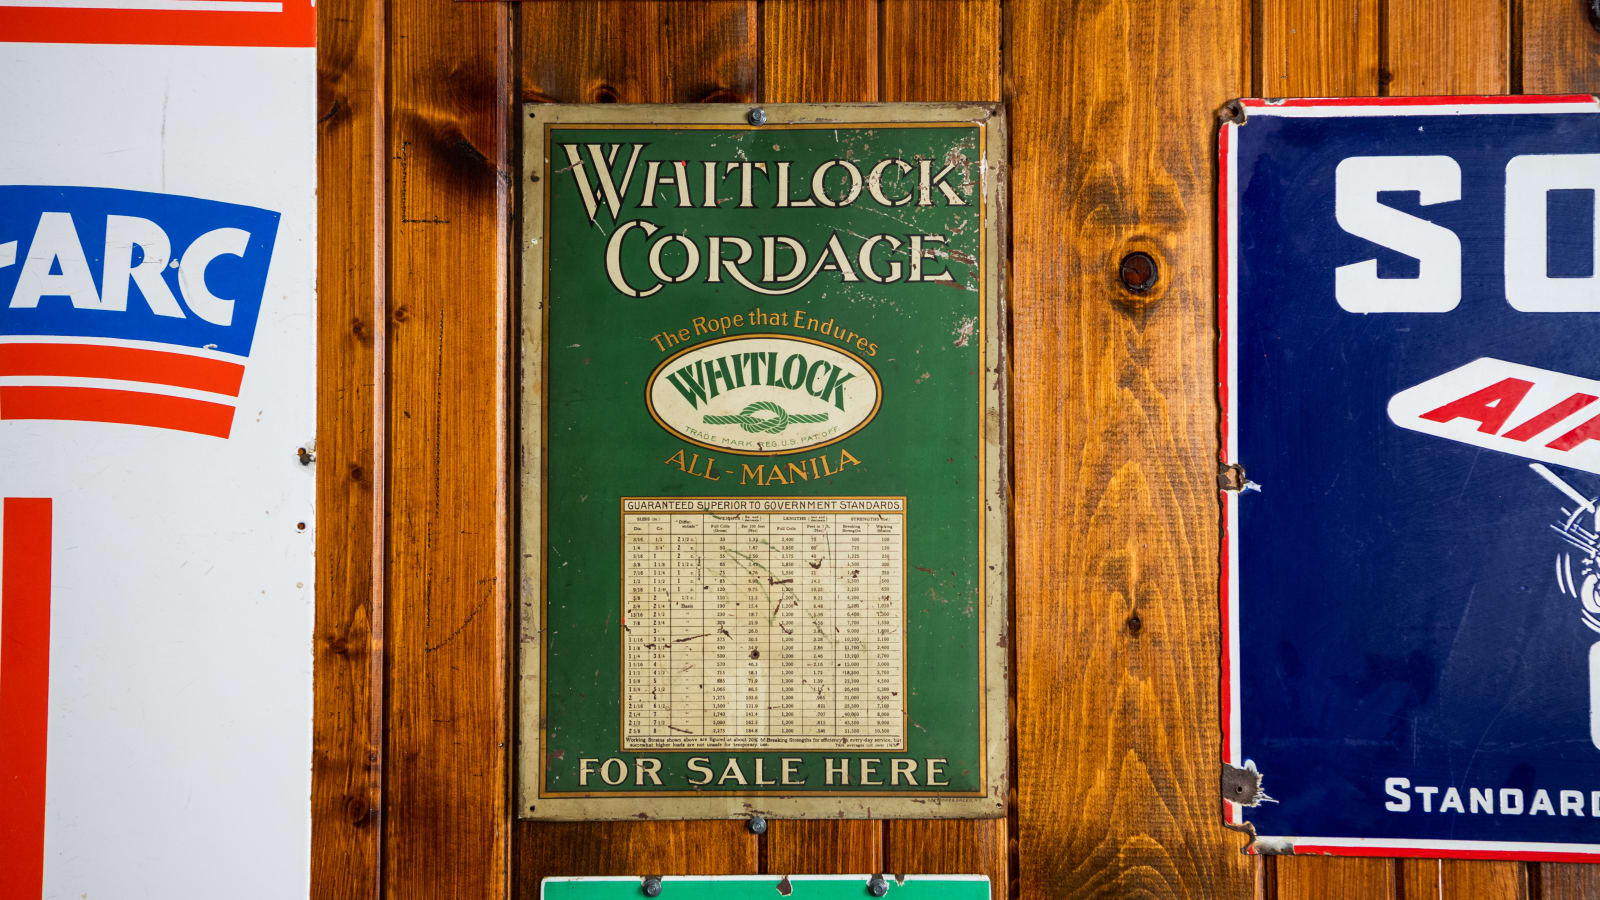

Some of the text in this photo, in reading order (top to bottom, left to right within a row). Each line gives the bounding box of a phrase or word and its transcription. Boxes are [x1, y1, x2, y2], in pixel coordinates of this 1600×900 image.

[557, 142, 974, 226] WHITLOCK
[0, 211, 251, 327] ARC
[605, 219, 958, 298] CORDAGE
[650, 308, 879, 357] The Rope that Endures
[666, 351, 855, 412] WHITLOCK
[685, 425, 716, 441] TRADE
[781, 439, 798, 447] U.S.
[664, 448, 721, 481] ALL
[740, 448, 861, 486] MANILA
[627, 501, 902, 510] GUARANTEED SUPERIOR TO GOVERNMENT STANDARDS.
[577, 757, 951, 787] FOR SALE HERE
